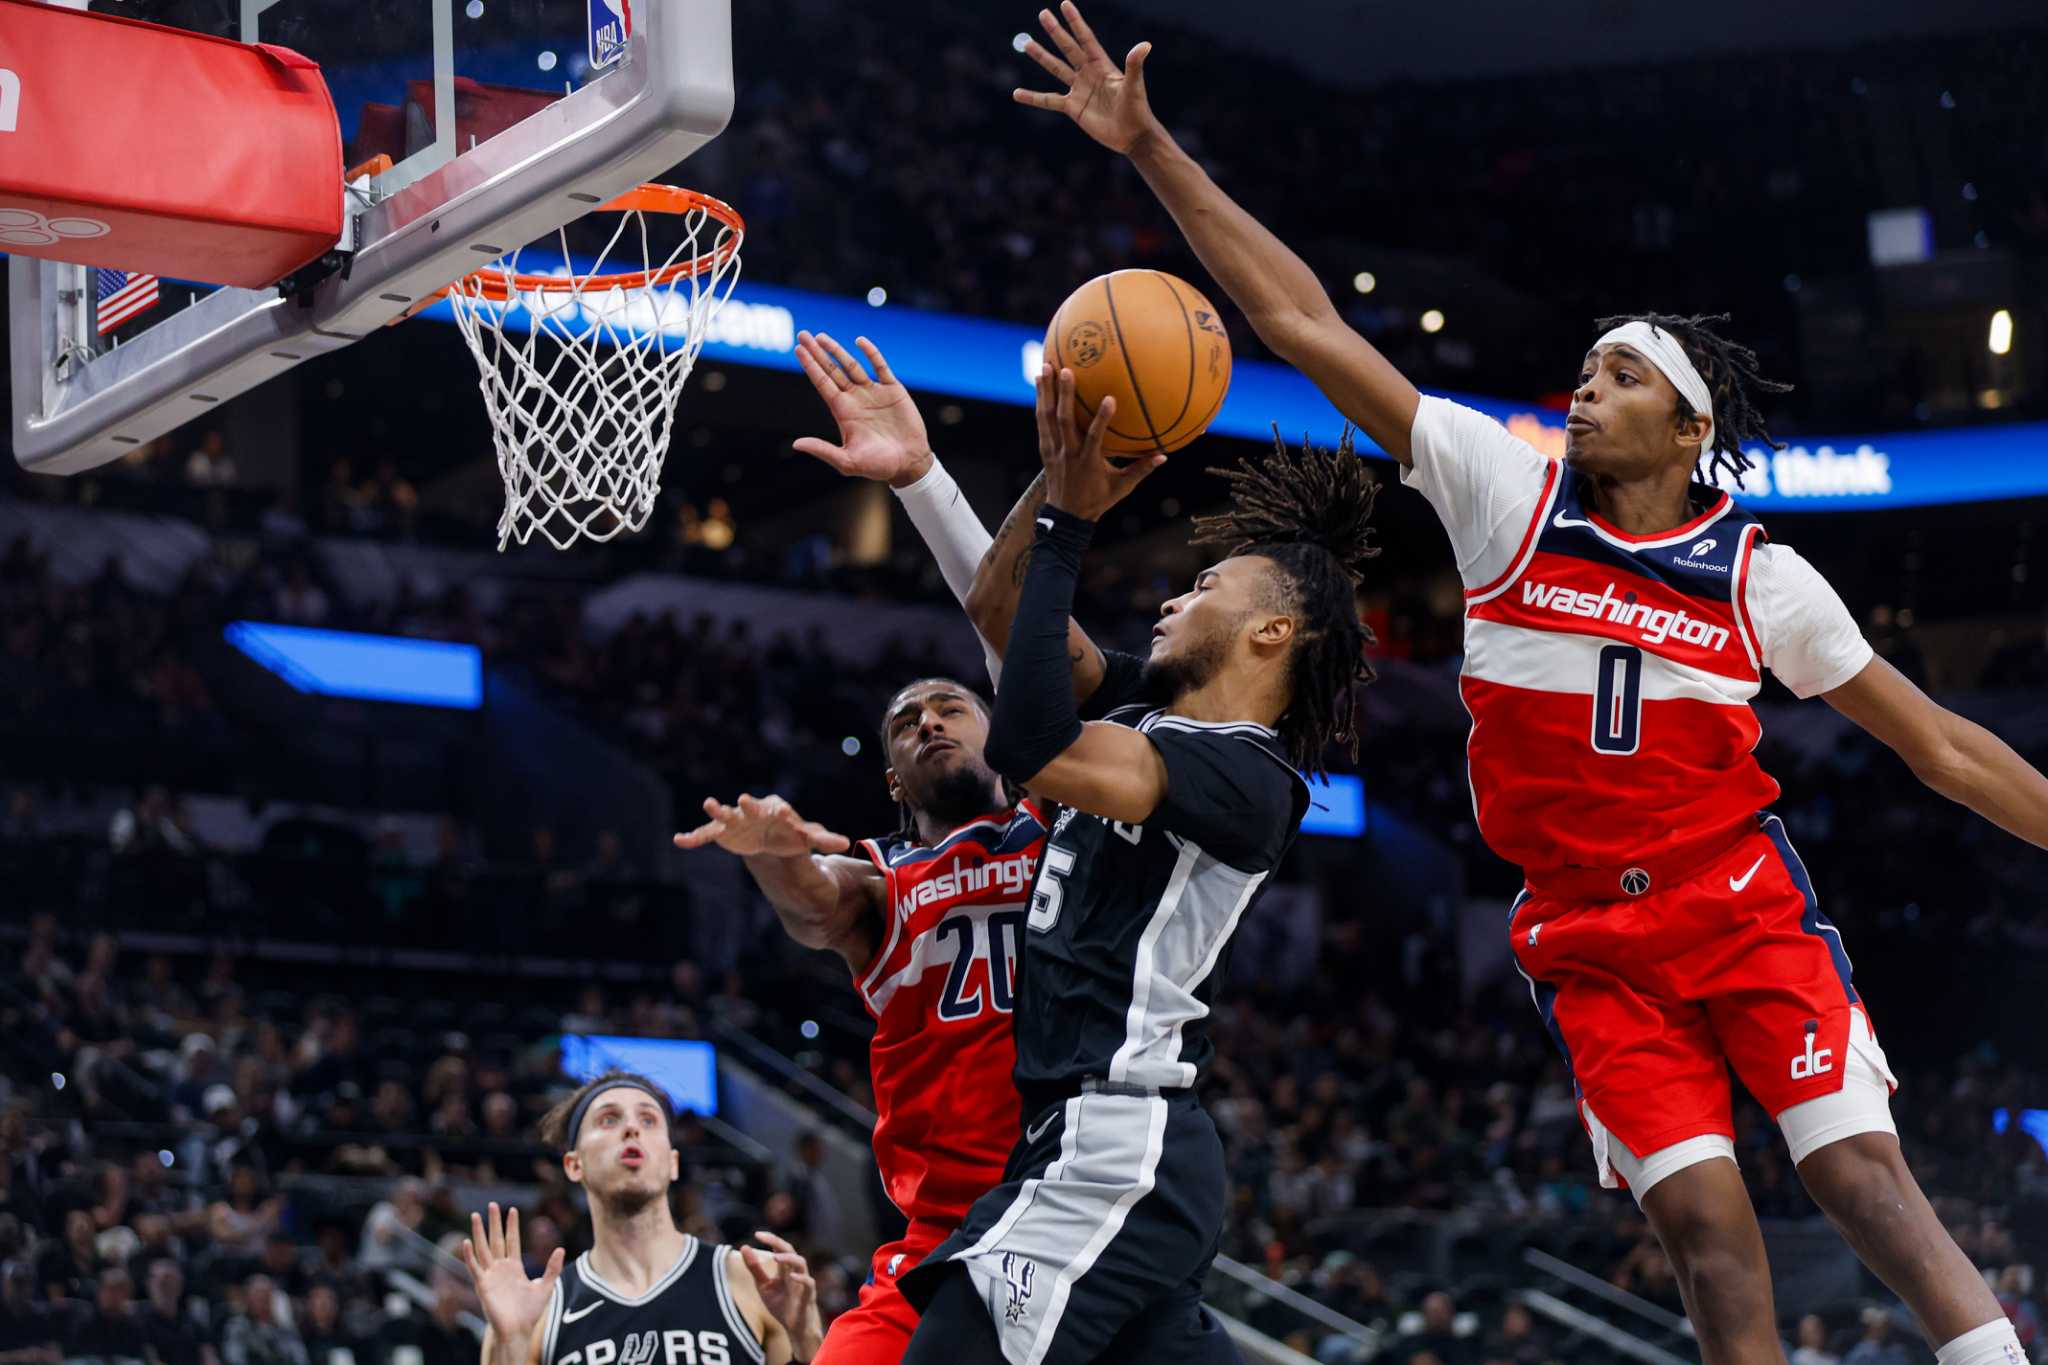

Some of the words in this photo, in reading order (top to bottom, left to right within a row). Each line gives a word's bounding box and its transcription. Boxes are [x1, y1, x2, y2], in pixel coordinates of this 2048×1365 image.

[595, 20, 618, 54] NBA
[1673, 556, 1728, 573] Robinhood
[1522, 580, 1730, 652] washington
[1590, 643, 1643, 756] 0
[898, 855, 1038, 923] washingt
[1026, 842, 1078, 934] 5
[935, 902, 1026, 1022] 20
